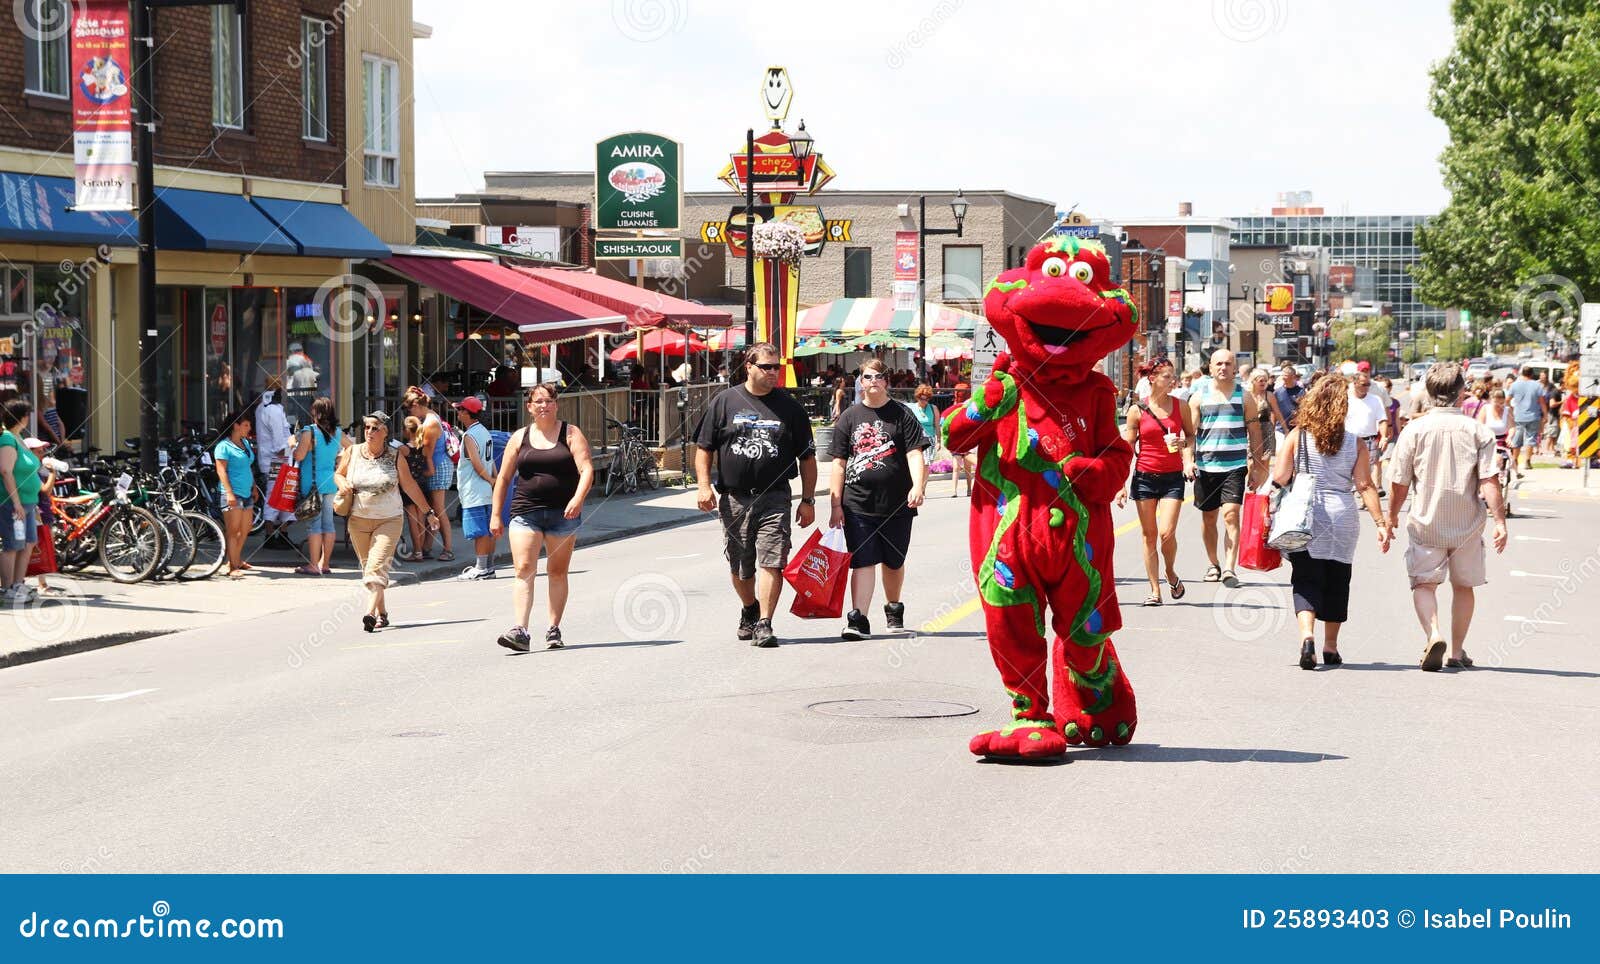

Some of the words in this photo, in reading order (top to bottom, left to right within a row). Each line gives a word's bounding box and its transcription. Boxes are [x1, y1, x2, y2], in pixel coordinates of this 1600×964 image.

[610, 144, 664, 158] AMIRA
[82, 178, 123, 189] Granby
[620, 210, 655, 218] CUISINE
[616, 219, 659, 227] LIBANAISE
[1055, 227, 1096, 238] inancière
[603, 245, 673, 254] SHISH-TAOUK
[1270, 315, 1293, 325] ESEL
[44, 327, 73, 339] EXPRESS
